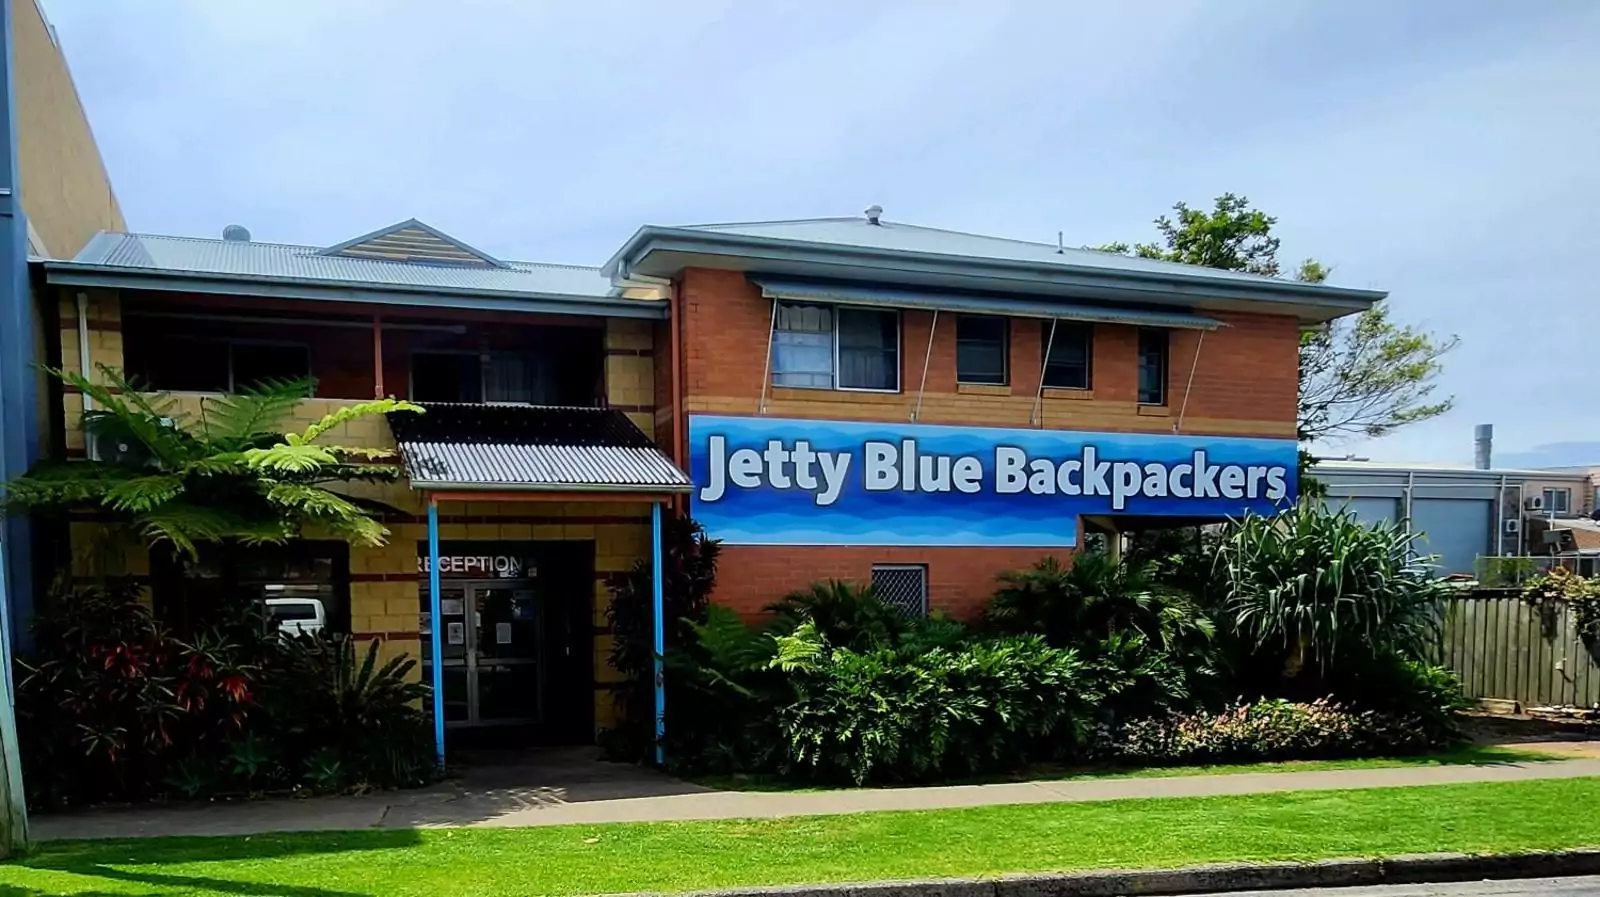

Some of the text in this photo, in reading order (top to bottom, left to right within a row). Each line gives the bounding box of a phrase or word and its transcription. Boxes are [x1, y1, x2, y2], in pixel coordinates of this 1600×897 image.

[702, 436, 1286, 510] Jetty Blue Backpackers
